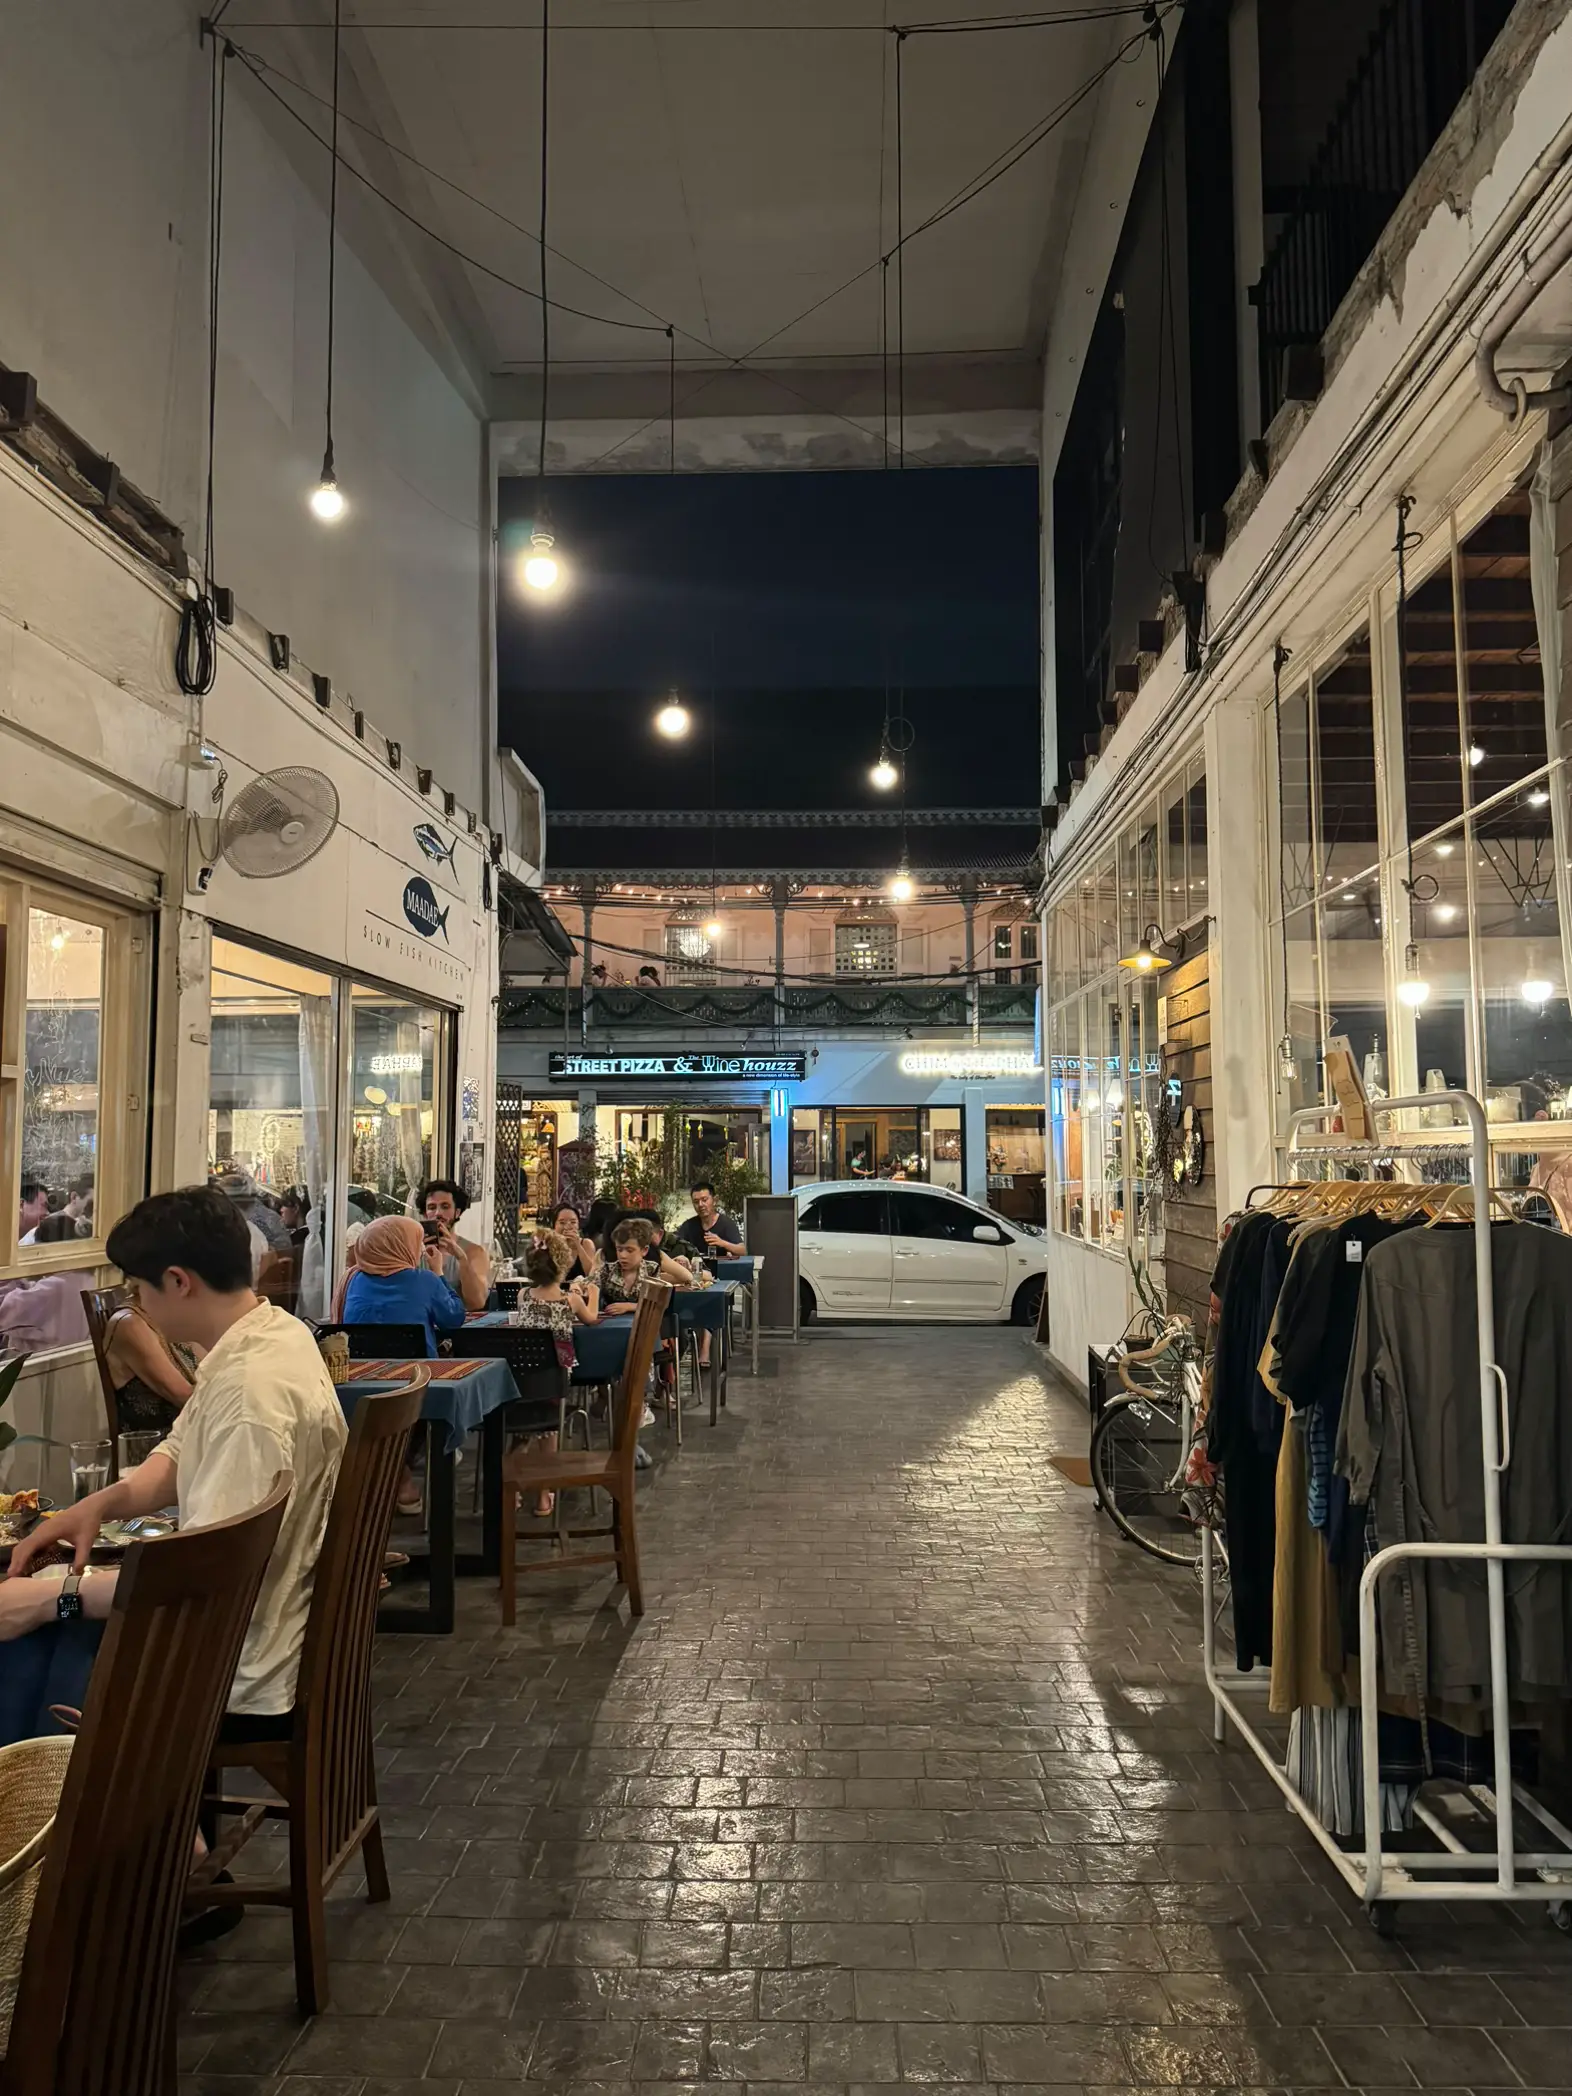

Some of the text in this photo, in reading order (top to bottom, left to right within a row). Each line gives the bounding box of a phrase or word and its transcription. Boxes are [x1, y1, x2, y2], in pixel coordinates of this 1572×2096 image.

[406, 888, 439, 928] MAADAE
[363, 925, 464, 982] SLOW FISH KITCHEN
[563, 1060, 618, 1073] STREET
[620, 1060, 666, 1073] PIZZA
[673, 1056, 693, 1074] &
[701, 1055, 741, 1073] Wine
[742, 1058, 797, 1072] houzz
